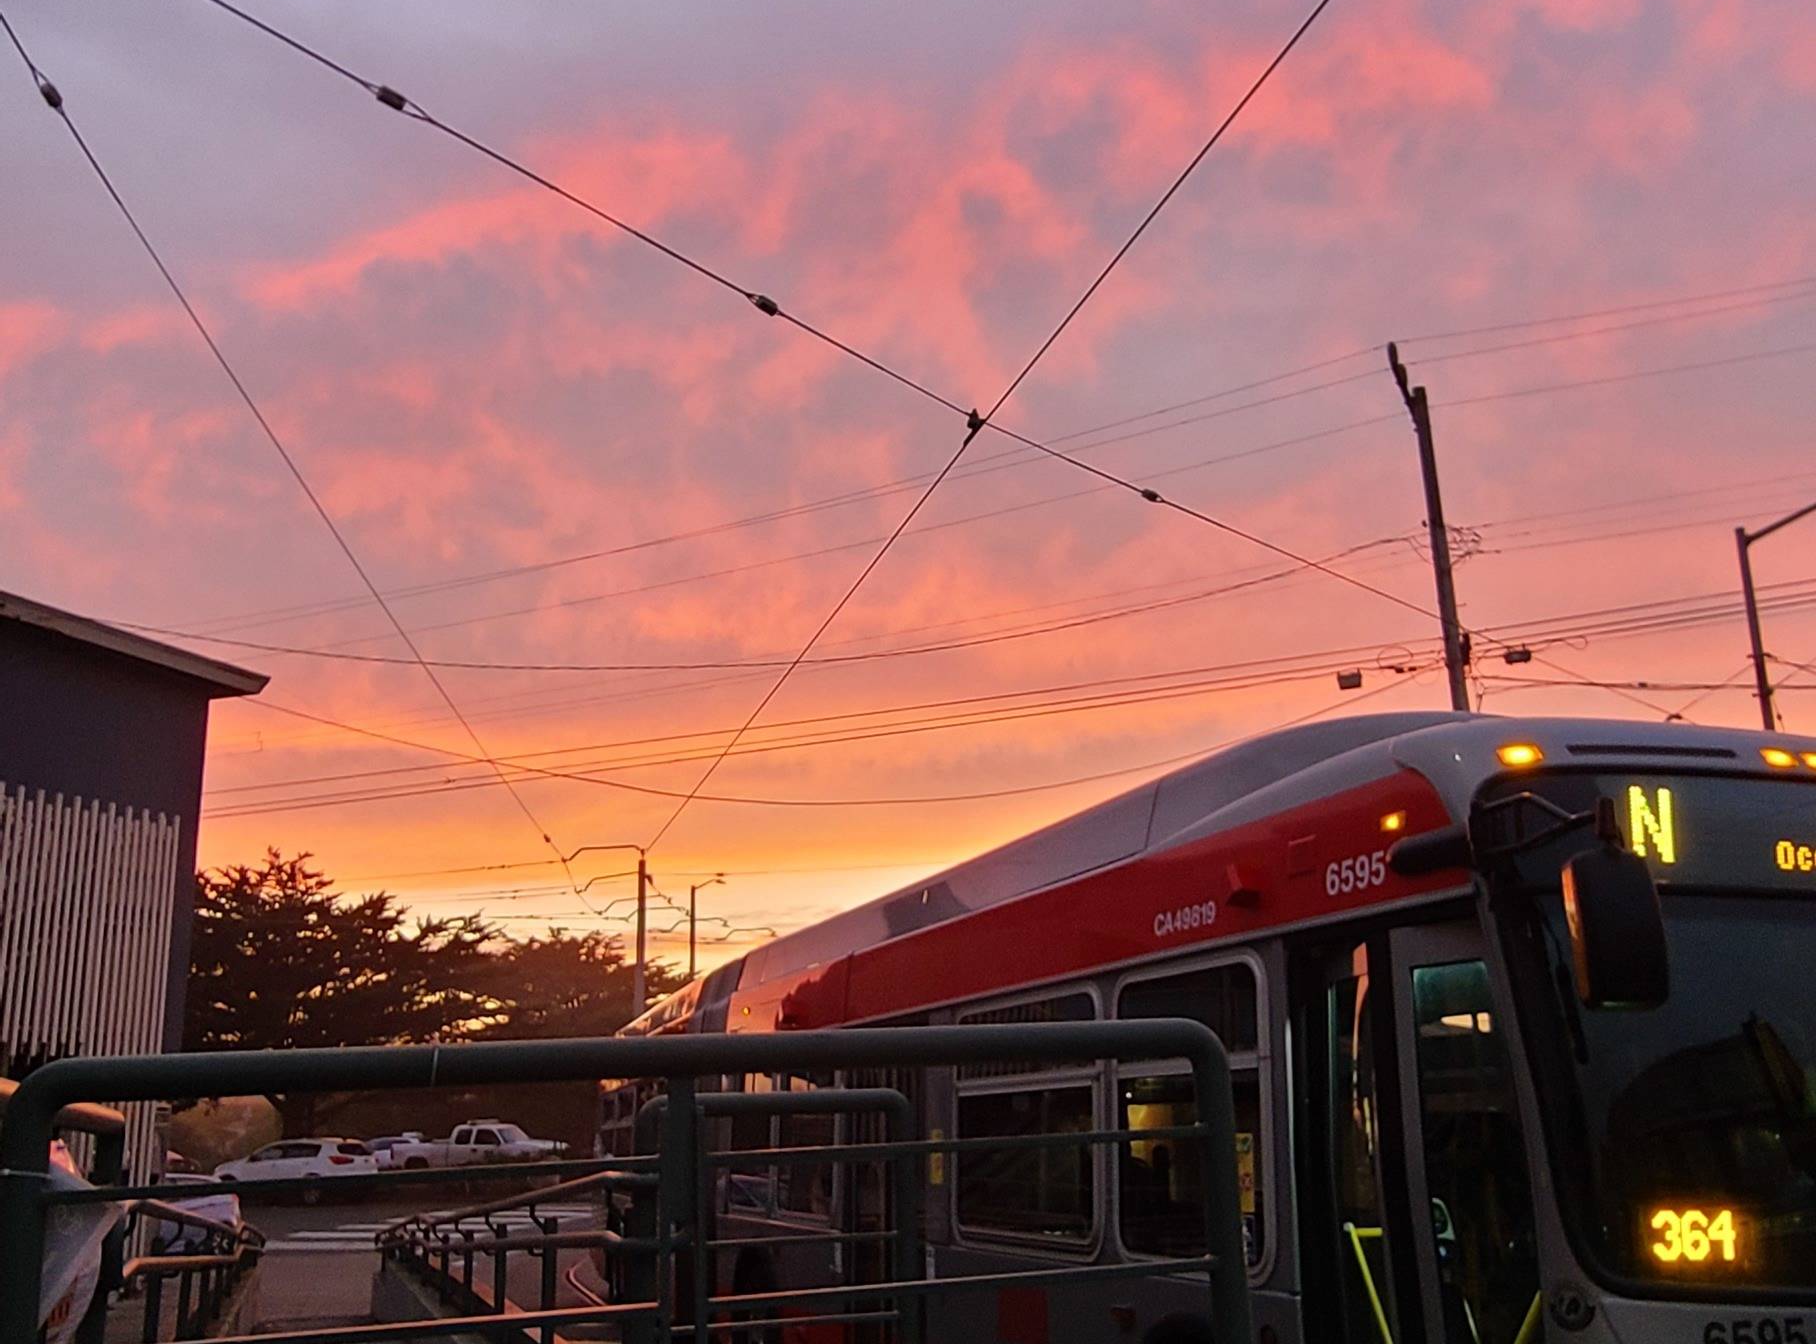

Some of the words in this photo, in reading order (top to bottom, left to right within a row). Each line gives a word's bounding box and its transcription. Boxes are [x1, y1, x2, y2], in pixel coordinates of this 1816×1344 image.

[1628, 785, 1676, 864] N
[1325, 850, 1386, 897] 6595
[1775, 840, 1816, 871] Oc
[1153, 900, 1217, 937] CA49819
[1651, 1209, 1737, 1261] 364
